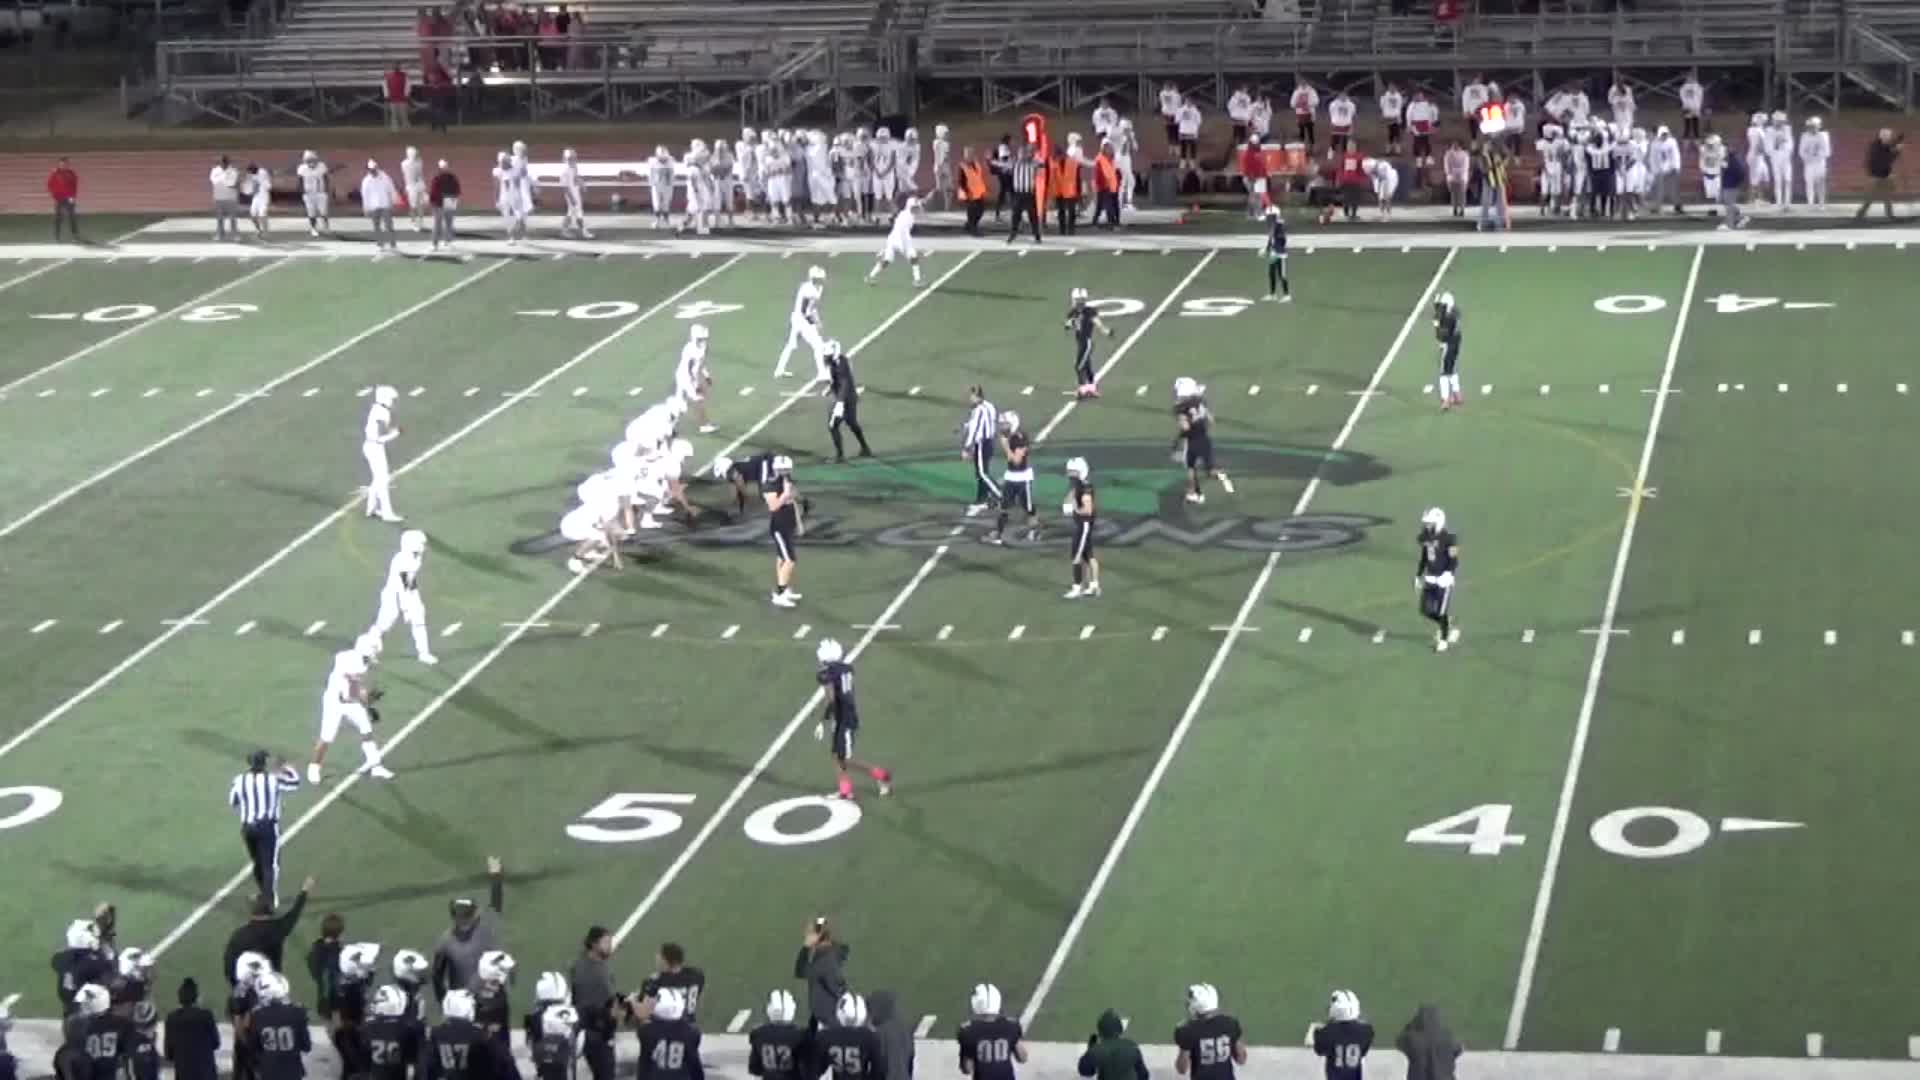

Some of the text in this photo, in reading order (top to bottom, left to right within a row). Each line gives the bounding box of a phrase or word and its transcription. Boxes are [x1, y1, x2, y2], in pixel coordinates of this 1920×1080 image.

[565, 792, 863, 845] 50
[1405, 803, 1711, 858] 40
[260, 1025, 295, 1051] 30
[1200, 1035, 1231, 1065] 56
[652, 1040, 685, 1070] 48
